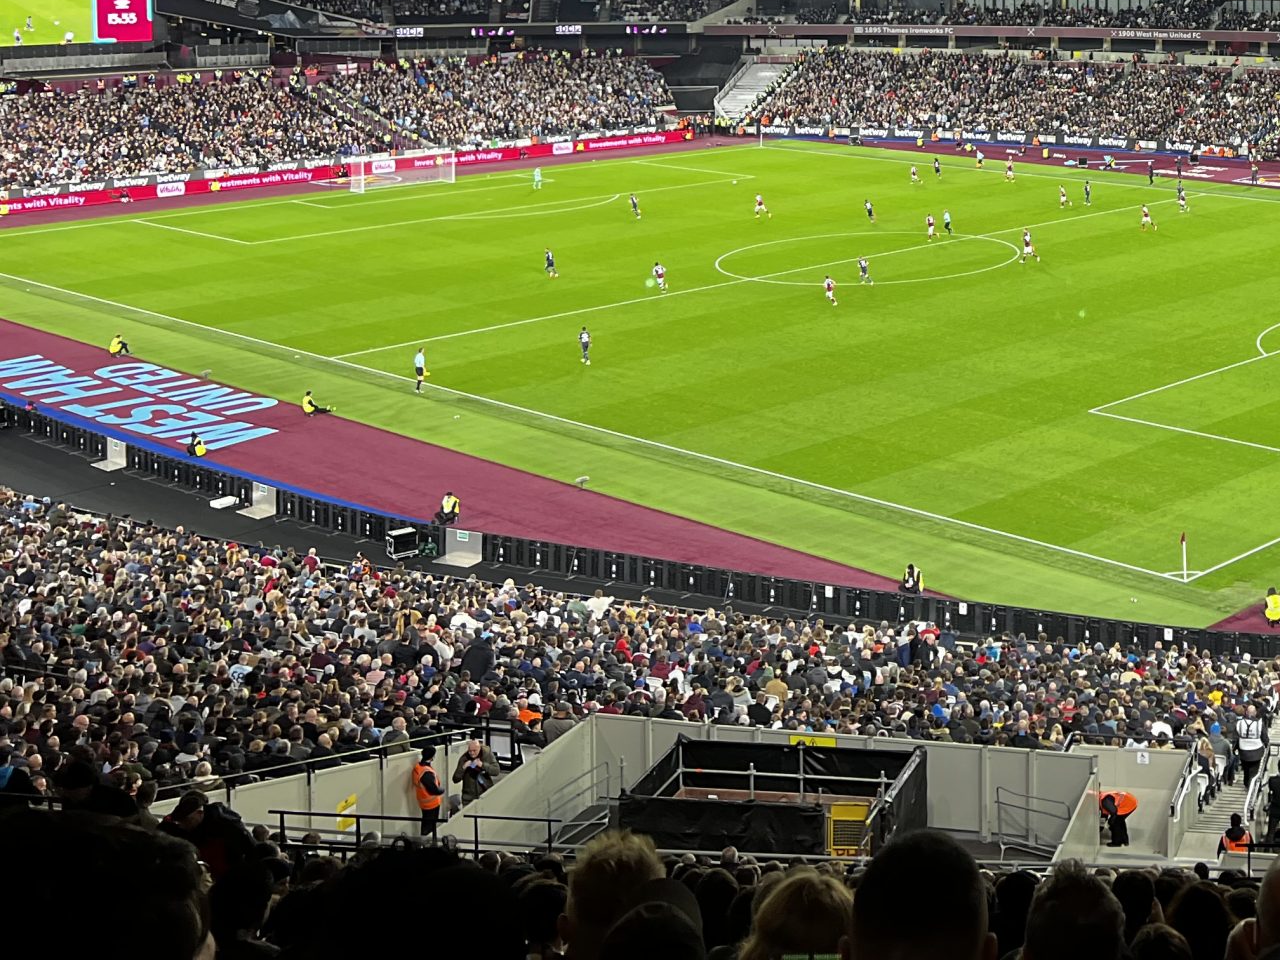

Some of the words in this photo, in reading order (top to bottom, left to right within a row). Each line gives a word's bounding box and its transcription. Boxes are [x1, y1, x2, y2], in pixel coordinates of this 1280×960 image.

[1136, 30, 1152, 38] West
[628, 138, 641, 146] with
[643, 135, 666, 144] Vitality
[477, 152, 503, 162] Vitality
[114, 176, 149, 188] betway
[157, 173, 191, 184] betway
[263, 174, 281, 184] with
[283, 171, 312, 182] Vitality
[69, 182, 105, 192] betway
[24, 198, 47, 209] with
[49, 196, 86, 206] Vitality
[94, 362, 279, 416] UNITED
[60, 396, 279, 450] WEST
